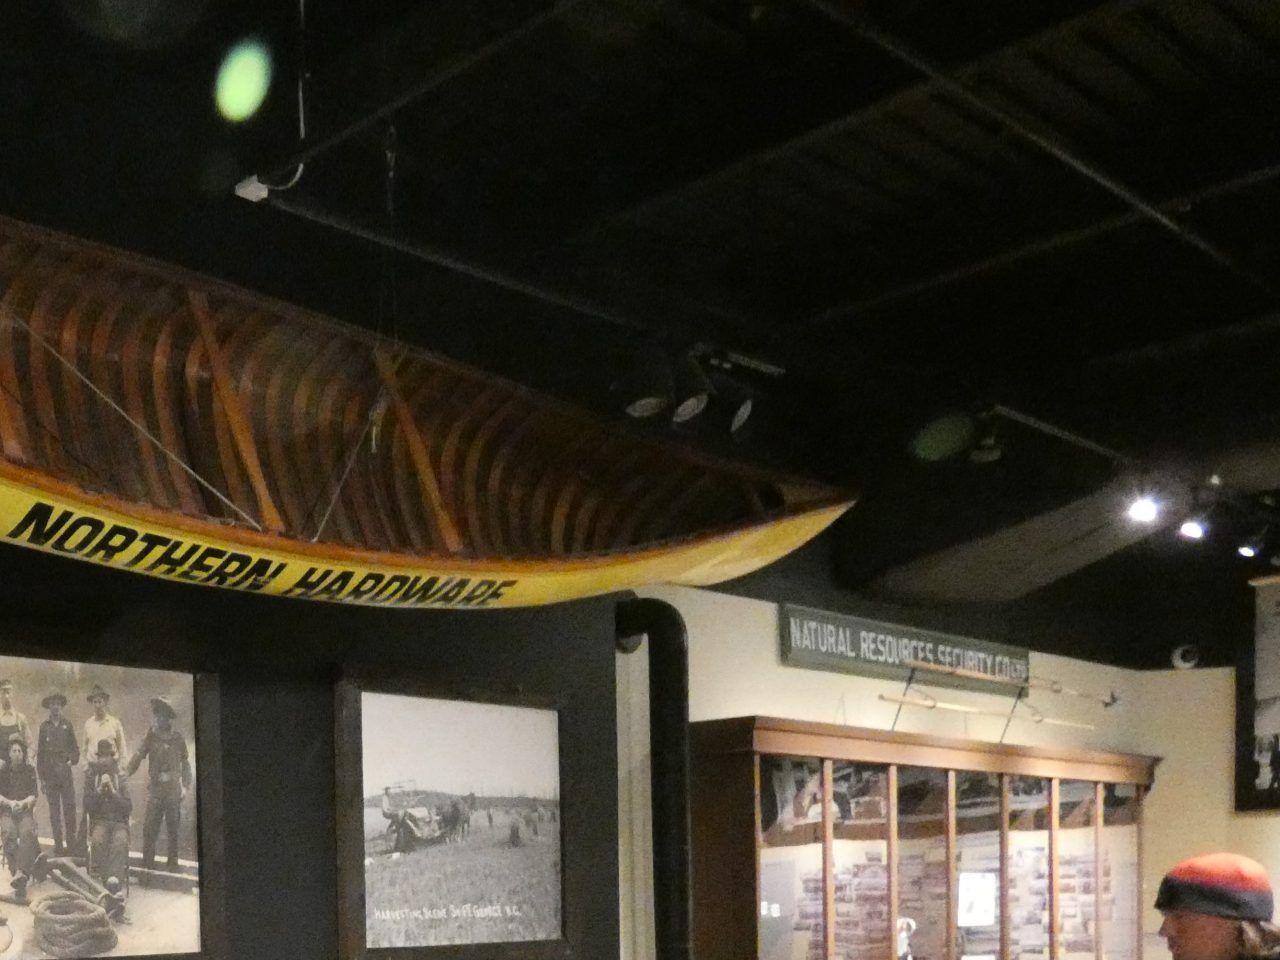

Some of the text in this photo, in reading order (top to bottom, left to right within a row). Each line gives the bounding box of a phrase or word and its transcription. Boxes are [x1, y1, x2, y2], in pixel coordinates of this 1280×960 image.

[7, 502, 518, 606] NORTHERN HARDWARE
[789, 616, 856, 658] NATURAL
[859, 630, 934, 666] RESOURCES
